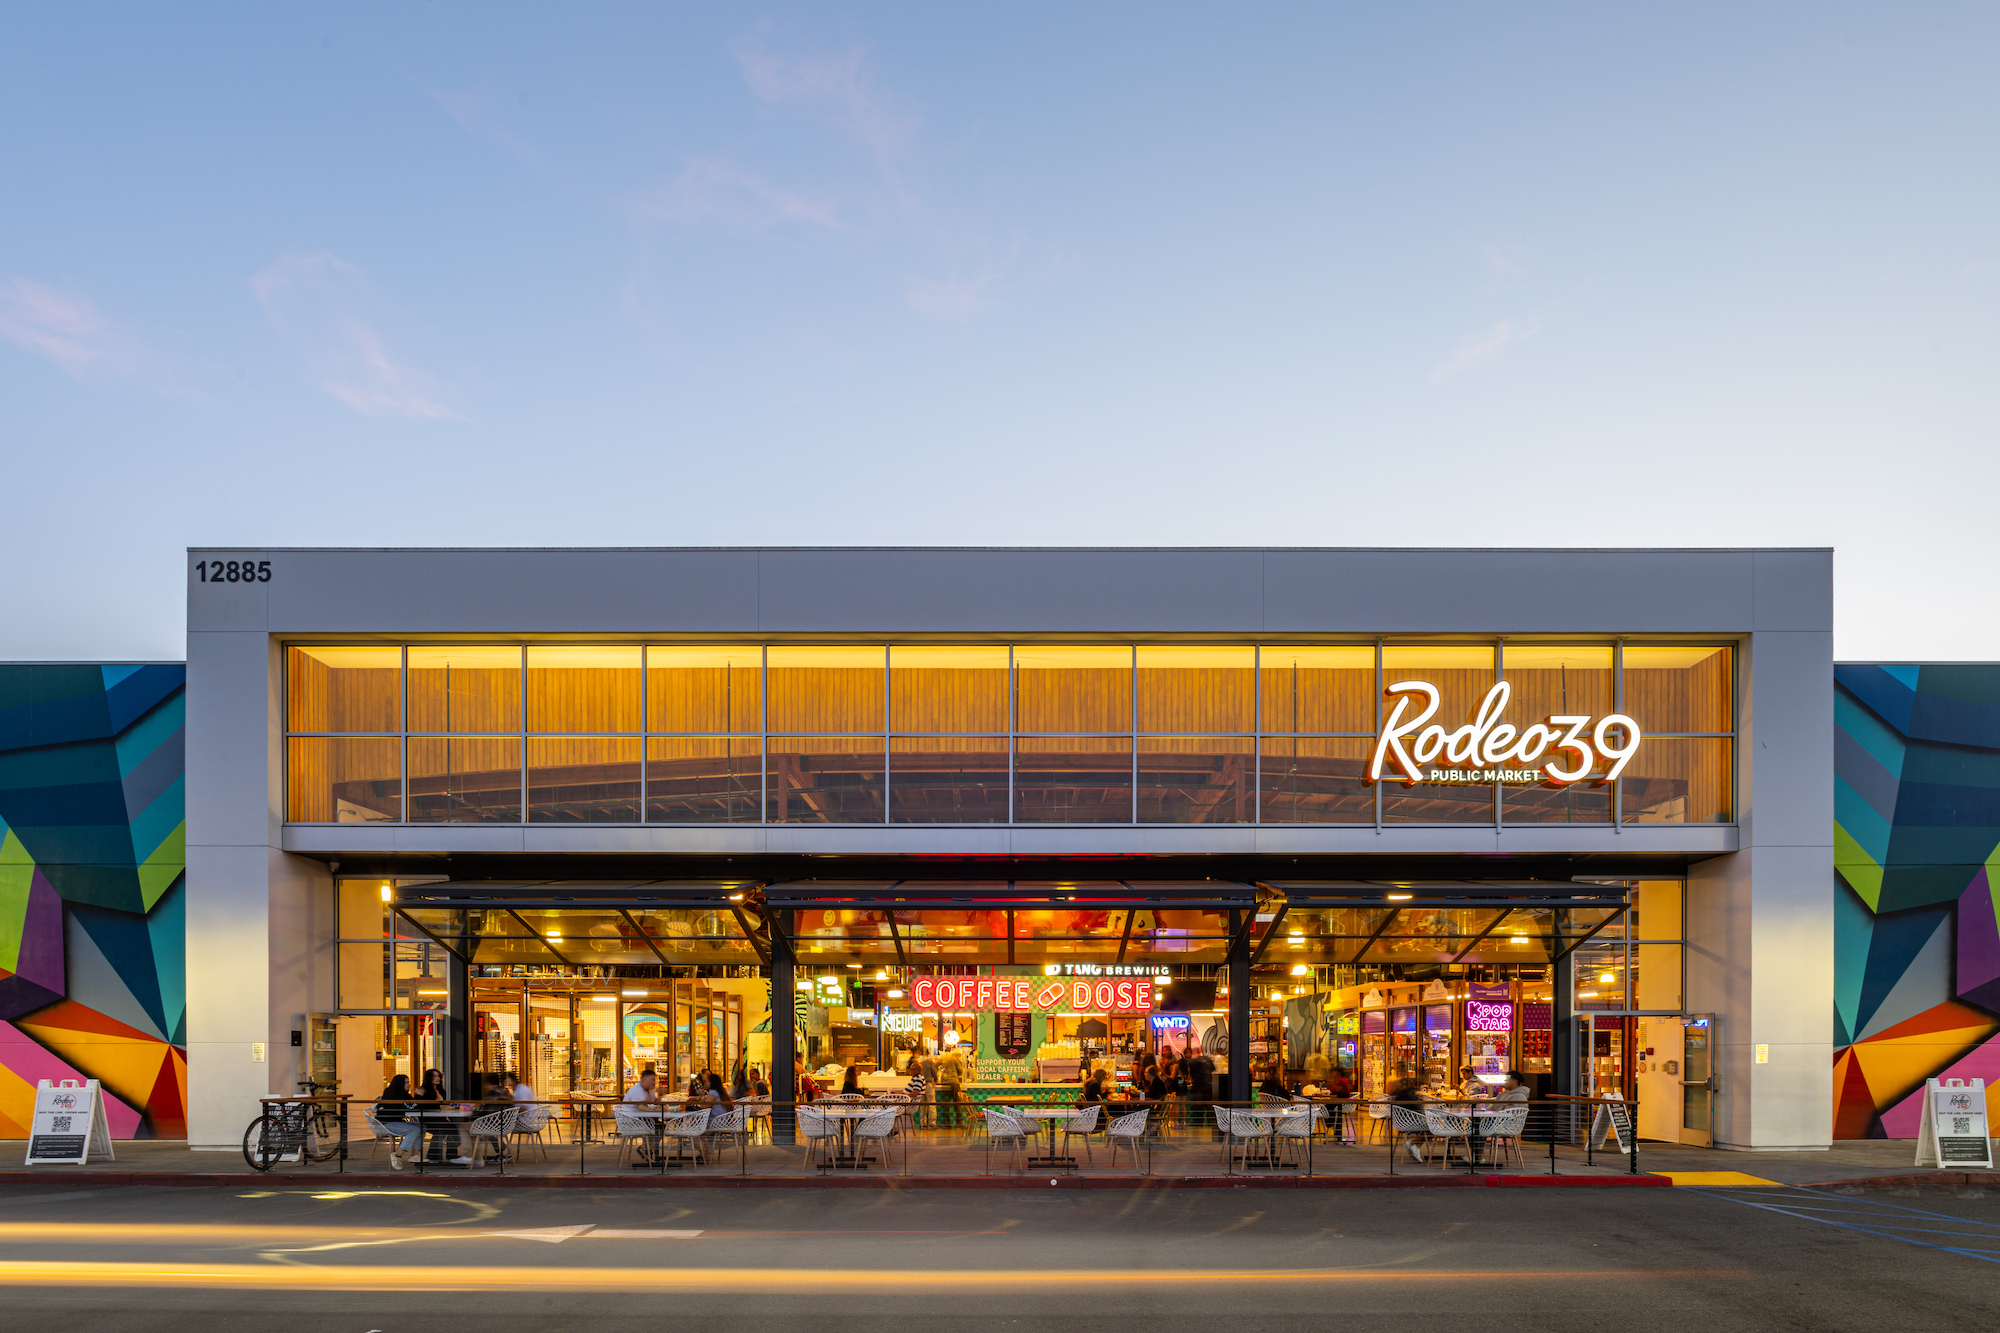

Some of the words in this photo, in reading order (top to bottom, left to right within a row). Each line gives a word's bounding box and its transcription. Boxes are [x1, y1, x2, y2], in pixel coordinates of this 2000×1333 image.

[196, 560, 272, 582] 12885
[1431, 770, 1480, 781] PUBLIC
[1487, 770, 1541, 781] MARKET
[528, 966, 616, 986] zeroUV
[1065, 964, 1102, 976] TANG
[1106, 966, 1170, 976] BREWING
[915, 980, 1030, 1009] COFFEE
[1073, 981, 1151, 1009] DOSE
[881, 1013, 923, 1032] NEUE
[1153, 1017, 1189, 1028] WNTD
[1470, 1018, 1511, 1031] STAR
[976, 1058, 1007, 1066] SUPPORT
[1008, 1058, 1026, 1066] YOUR
[52, 1095, 75, 1105] Rodeo
